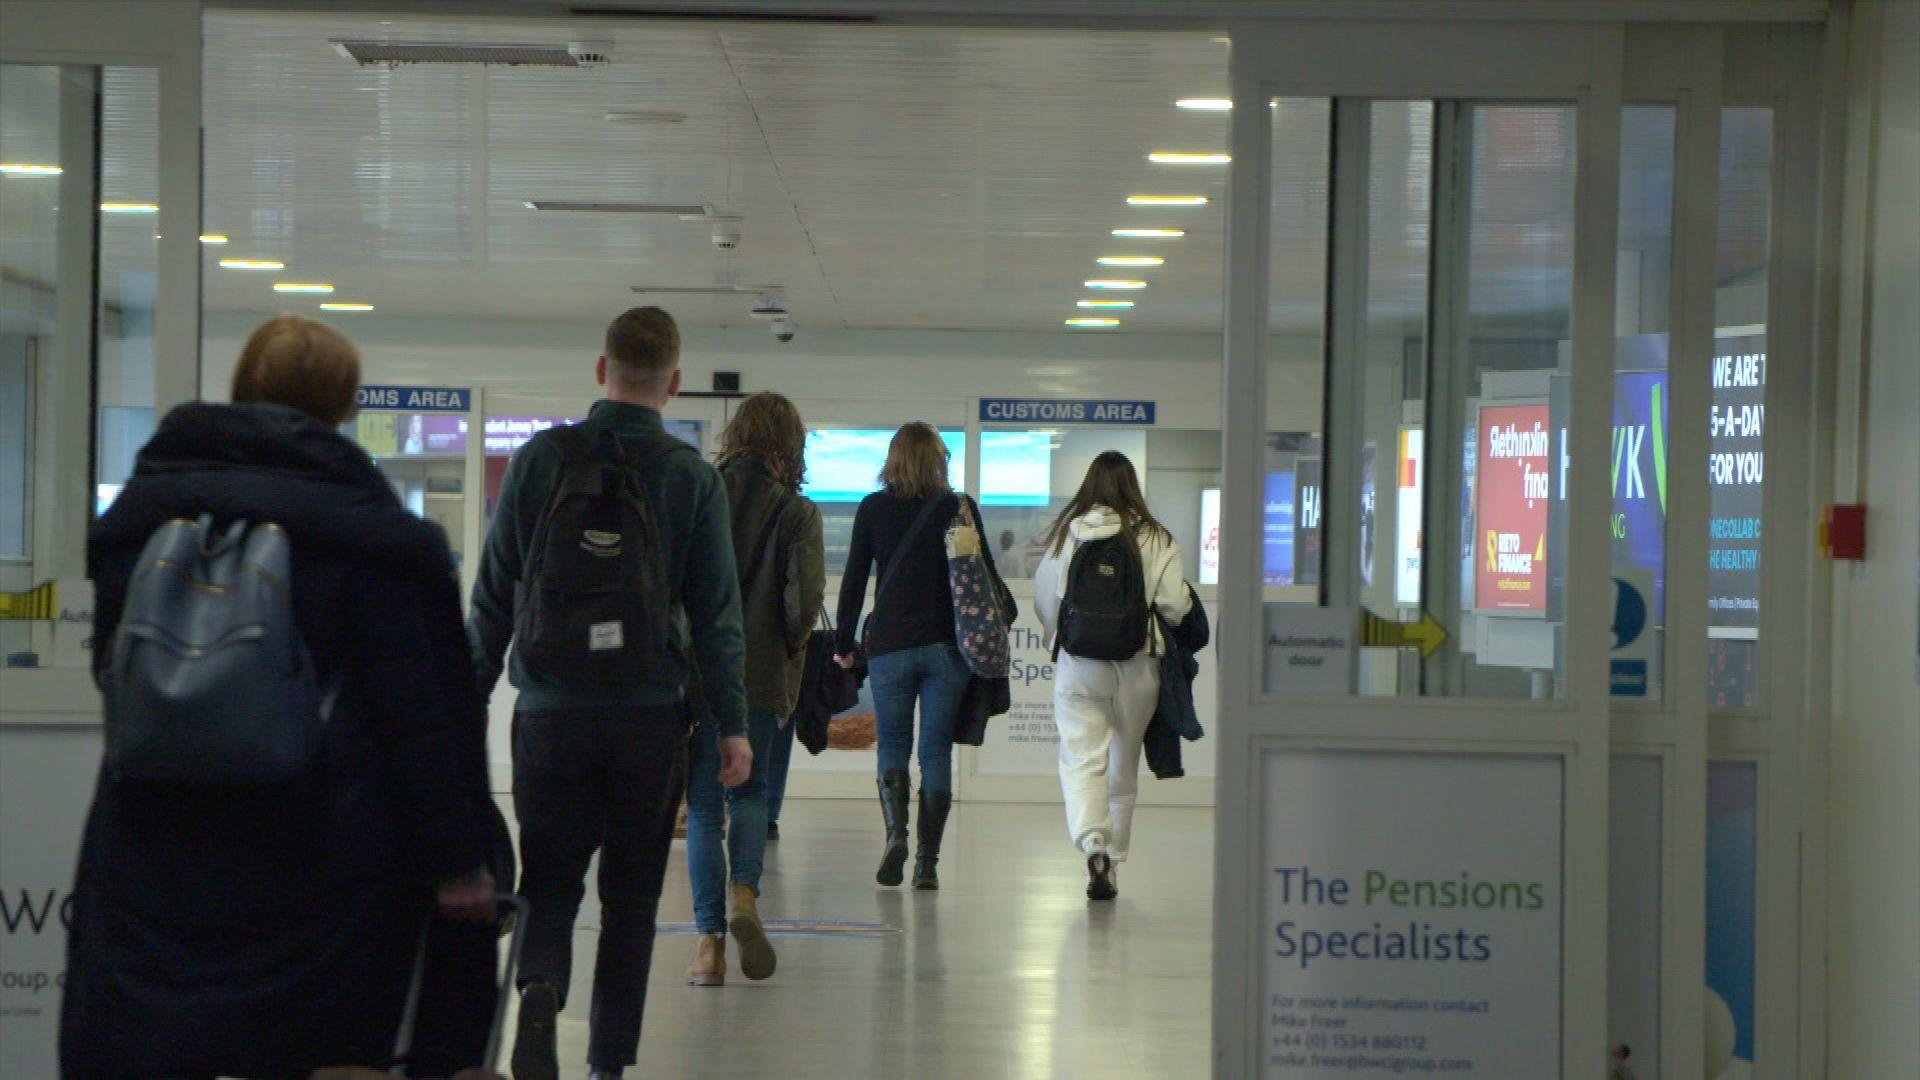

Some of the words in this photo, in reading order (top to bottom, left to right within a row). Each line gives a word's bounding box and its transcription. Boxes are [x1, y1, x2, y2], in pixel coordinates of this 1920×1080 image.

[1712, 356, 1732, 388] WE
[1733, 355, 1759, 387] ARE
[407, 391, 462, 407] AREA
[987, 402, 1085, 420] CUSTOMS
[1093, 404, 1147, 421] AREA
[1708, 453, 1734, 485] FOR
[1735, 451, 1764, 485] YOU
[1721, 550, 1758, 569] HEALTHY
[1269, 633, 1345, 649] Automatic
[1287, 653, 1324, 668] door
[1274, 866, 1349, 905] The
[1364, 869, 1544, 910] Pensions
[1275, 920, 1491, 968] Specialists
[1271, 995, 1294, 1008] For
[1299, 997, 1337, 1010] more
[1342, 995, 1429, 1012] information
[1434, 1000, 1489, 1013] contact
[1271, 1014, 1307, 1027] Mike
[1311, 1015, 1347, 1028] Freer
[1272, 1034, 1302, 1047] +44
[1306, 1034, 1328, 1050] (0)
[1333, 1034, 1369, 1049] 1534
